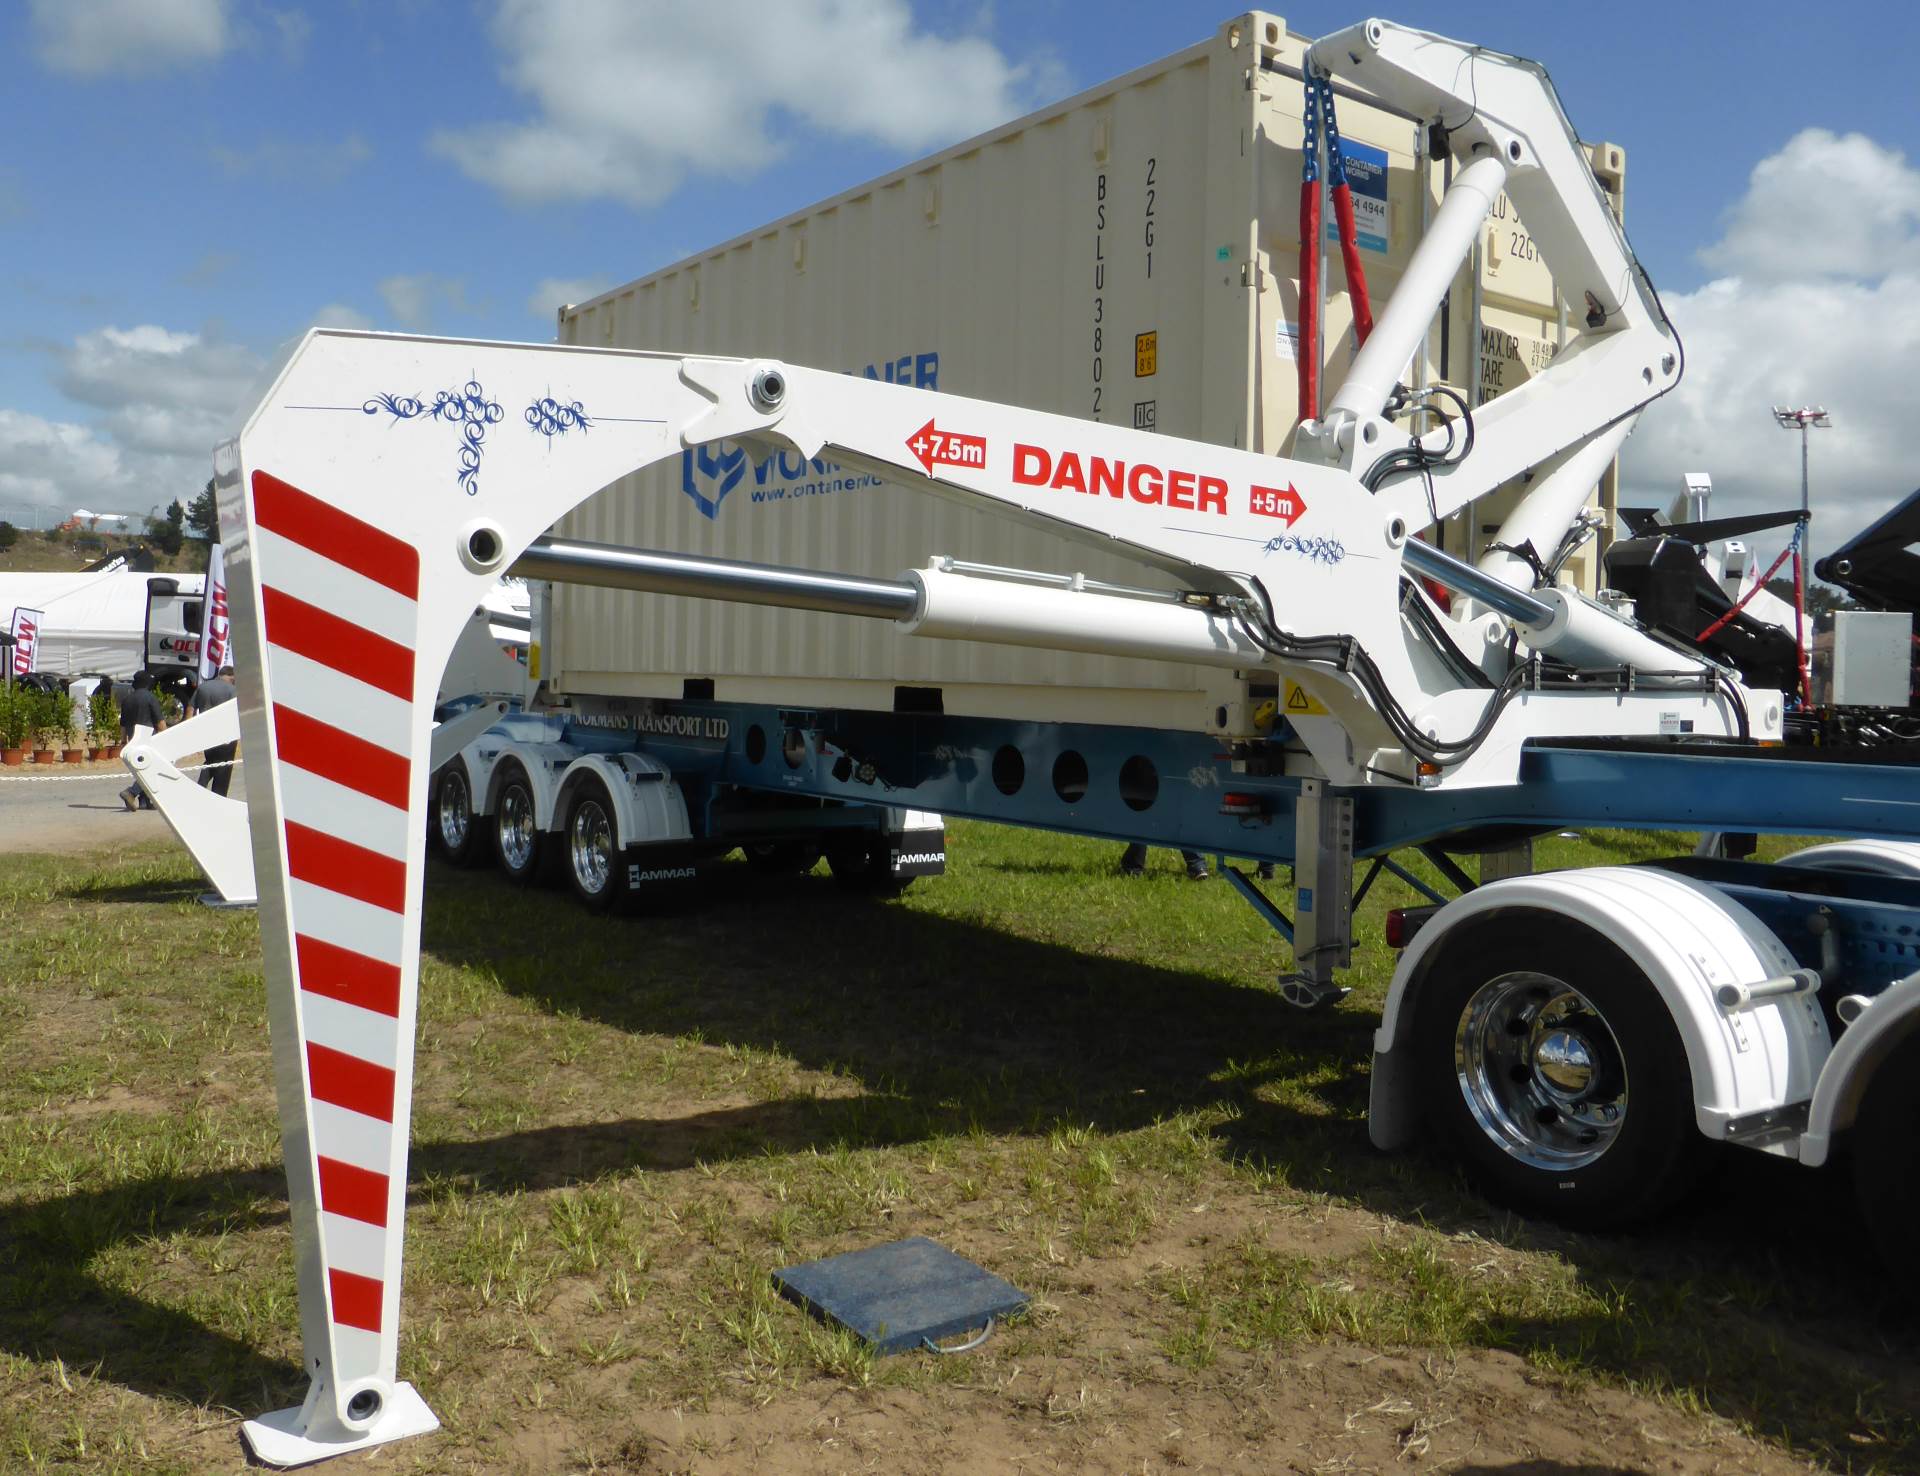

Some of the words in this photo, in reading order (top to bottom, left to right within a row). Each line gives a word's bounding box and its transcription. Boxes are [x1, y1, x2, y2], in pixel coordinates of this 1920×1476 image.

[1145, 158, 1156, 279] 22G1
[1362, 200, 1385, 217] 4944
[1481, 357, 1504, 387] TARE
[913, 434, 982, 463] +7.5m
[1012, 443, 1229, 516] DANGER
[1252, 492, 1293, 516] +5m
[207, 581, 229, 666] OCW
[15, 616, 37, 673] OCW
[632, 714, 701, 737] TRANSPORT
[705, 717, 729, 738] LTD
[891, 852, 945, 866] HAMMAR
[628, 865, 696, 884] HAMMAR
